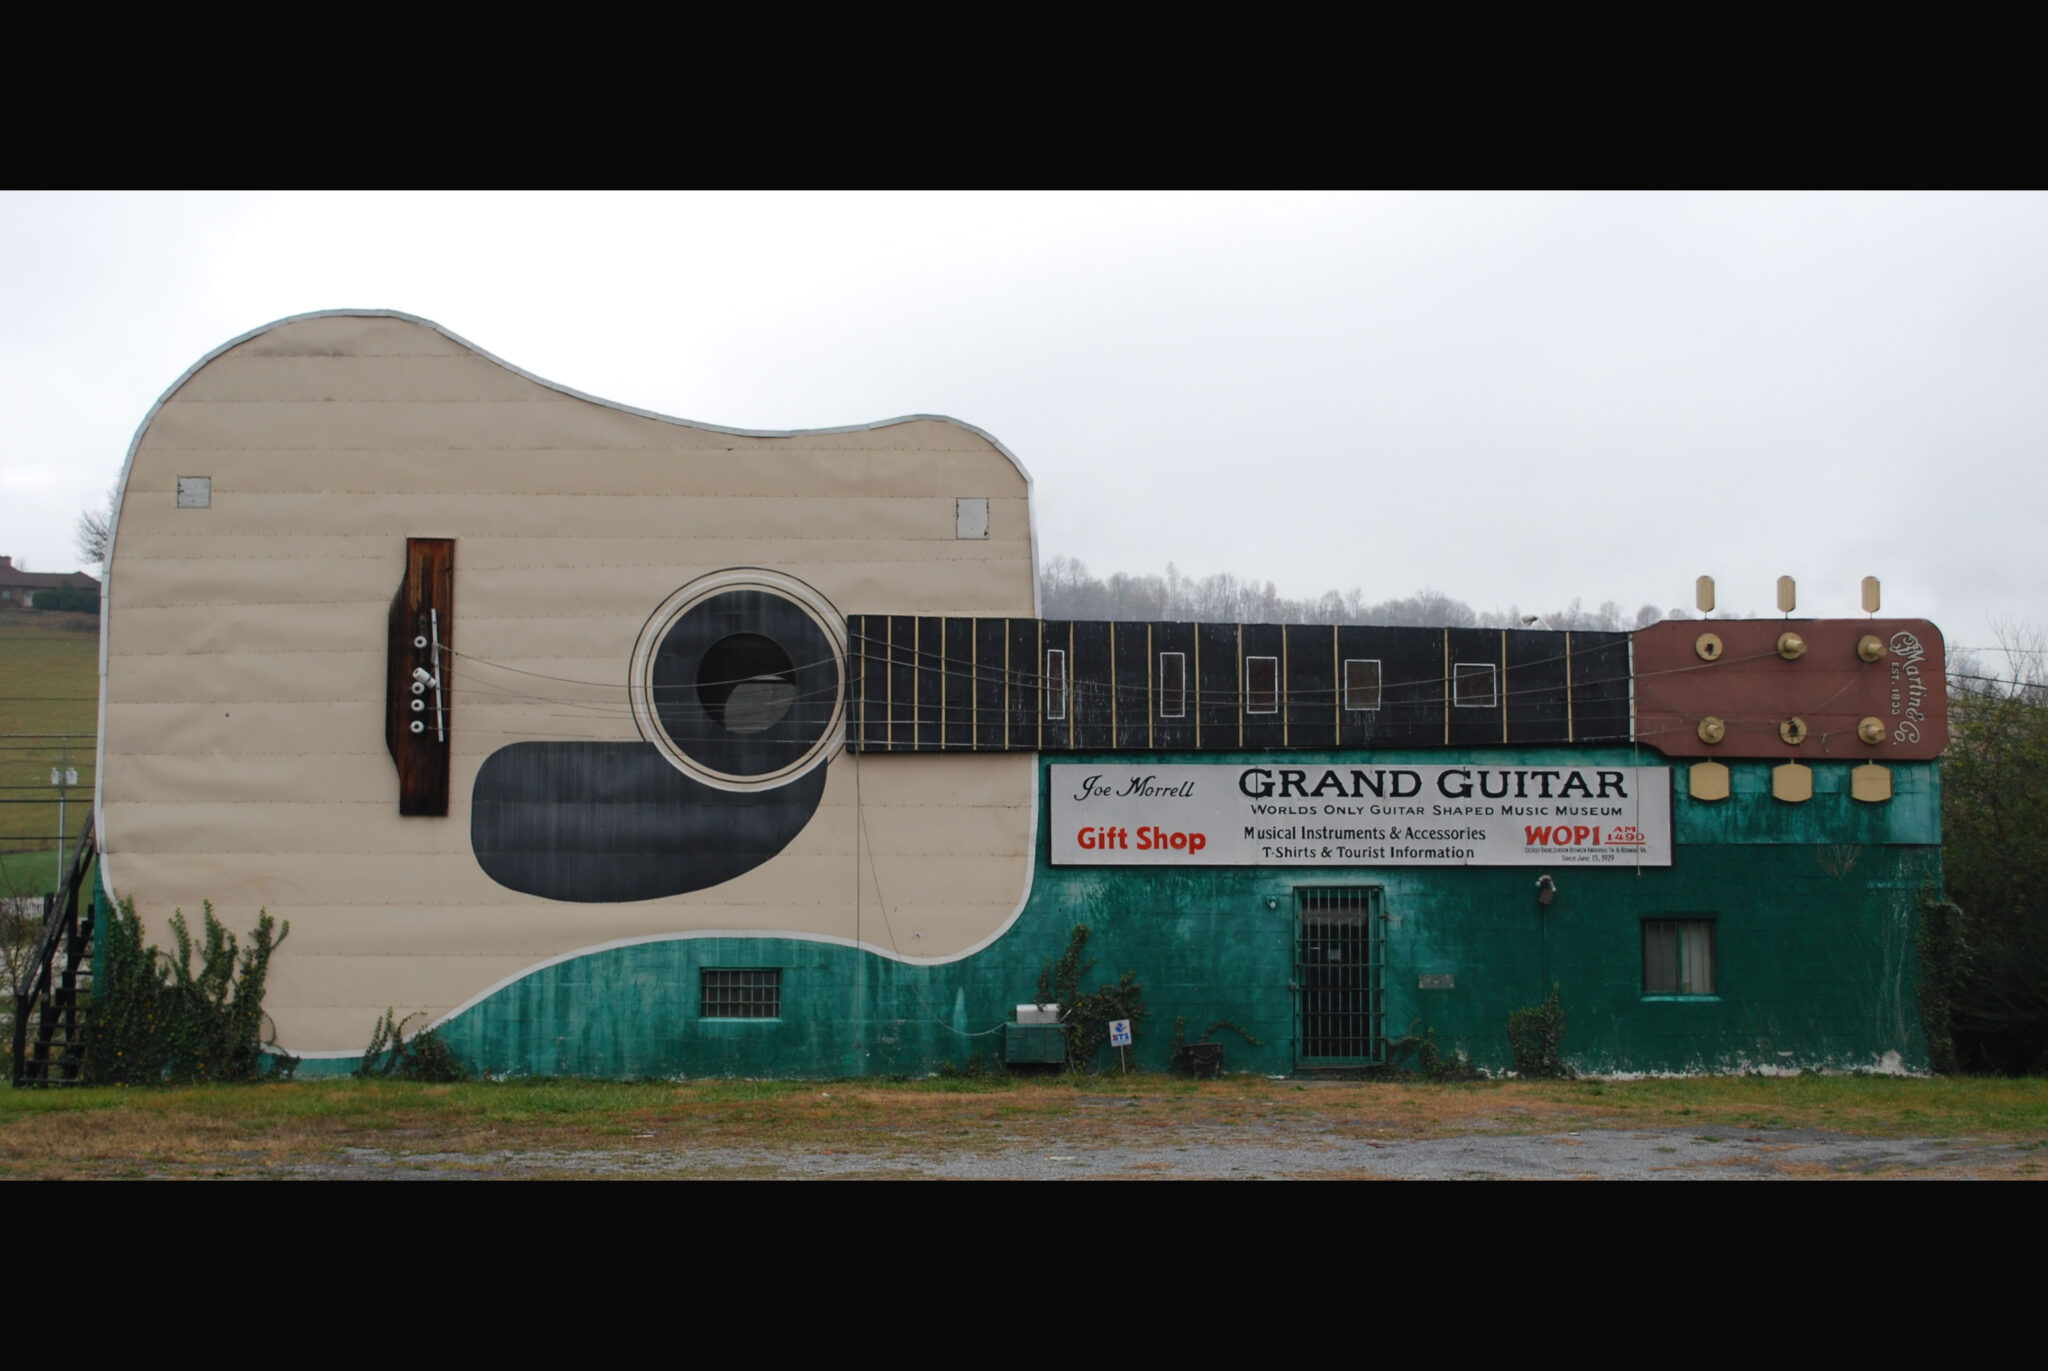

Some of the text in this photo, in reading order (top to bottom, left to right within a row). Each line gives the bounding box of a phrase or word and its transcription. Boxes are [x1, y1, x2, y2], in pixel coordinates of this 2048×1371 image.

[1891, 661, 1900, 686] EST.
[1073, 774, 1196, 801] Joe Morrell
[1238, 768, 1629, 799] GRAND GUITAR
[1243, 825, 1487, 841] Musical Instruments & Accessories
[1524, 825, 1601, 846] WOPI
[1607, 833, 1646, 841] 1490
[1613, 825, 1637, 833] AM
[1077, 826, 1207, 855] Gift Shop
[1262, 846, 1475, 860] T-Shirts & Tourist Information
